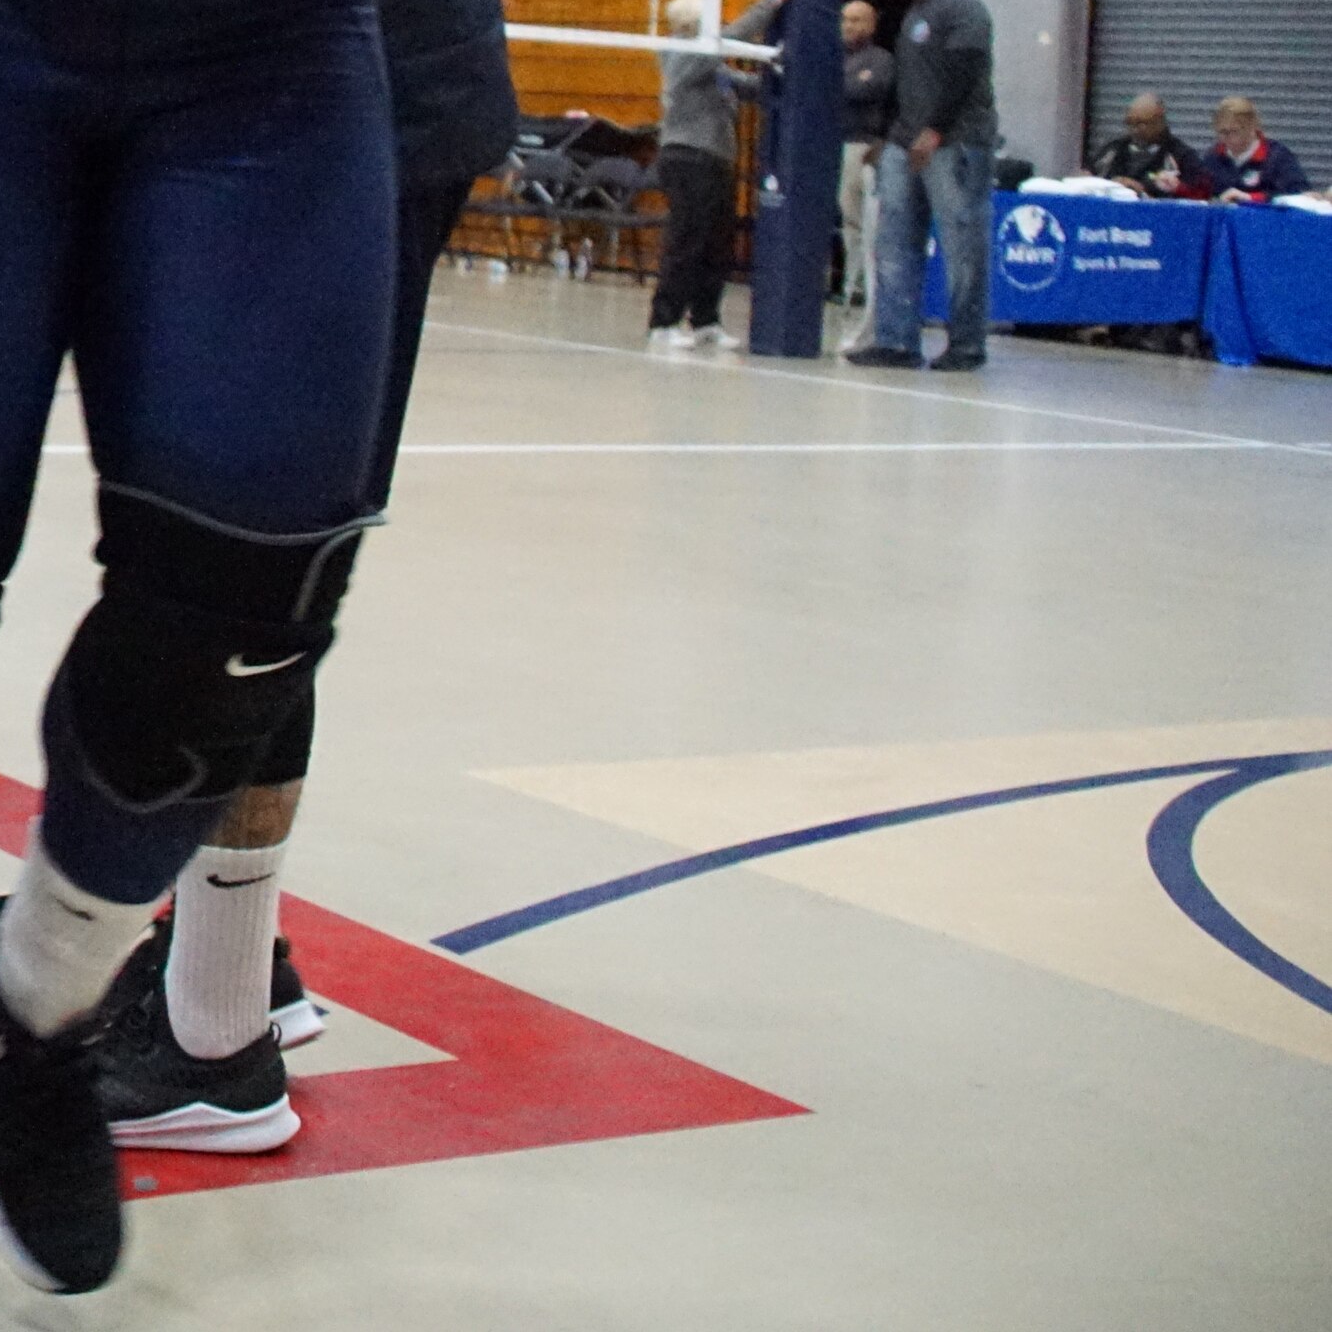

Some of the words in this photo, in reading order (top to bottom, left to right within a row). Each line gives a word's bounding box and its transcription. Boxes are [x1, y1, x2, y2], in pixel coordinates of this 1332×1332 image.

[1077, 225, 1108, 243] Fort
[1109, 225, 1153, 248] Bragg
[1005, 244, 1056, 264] MWR
